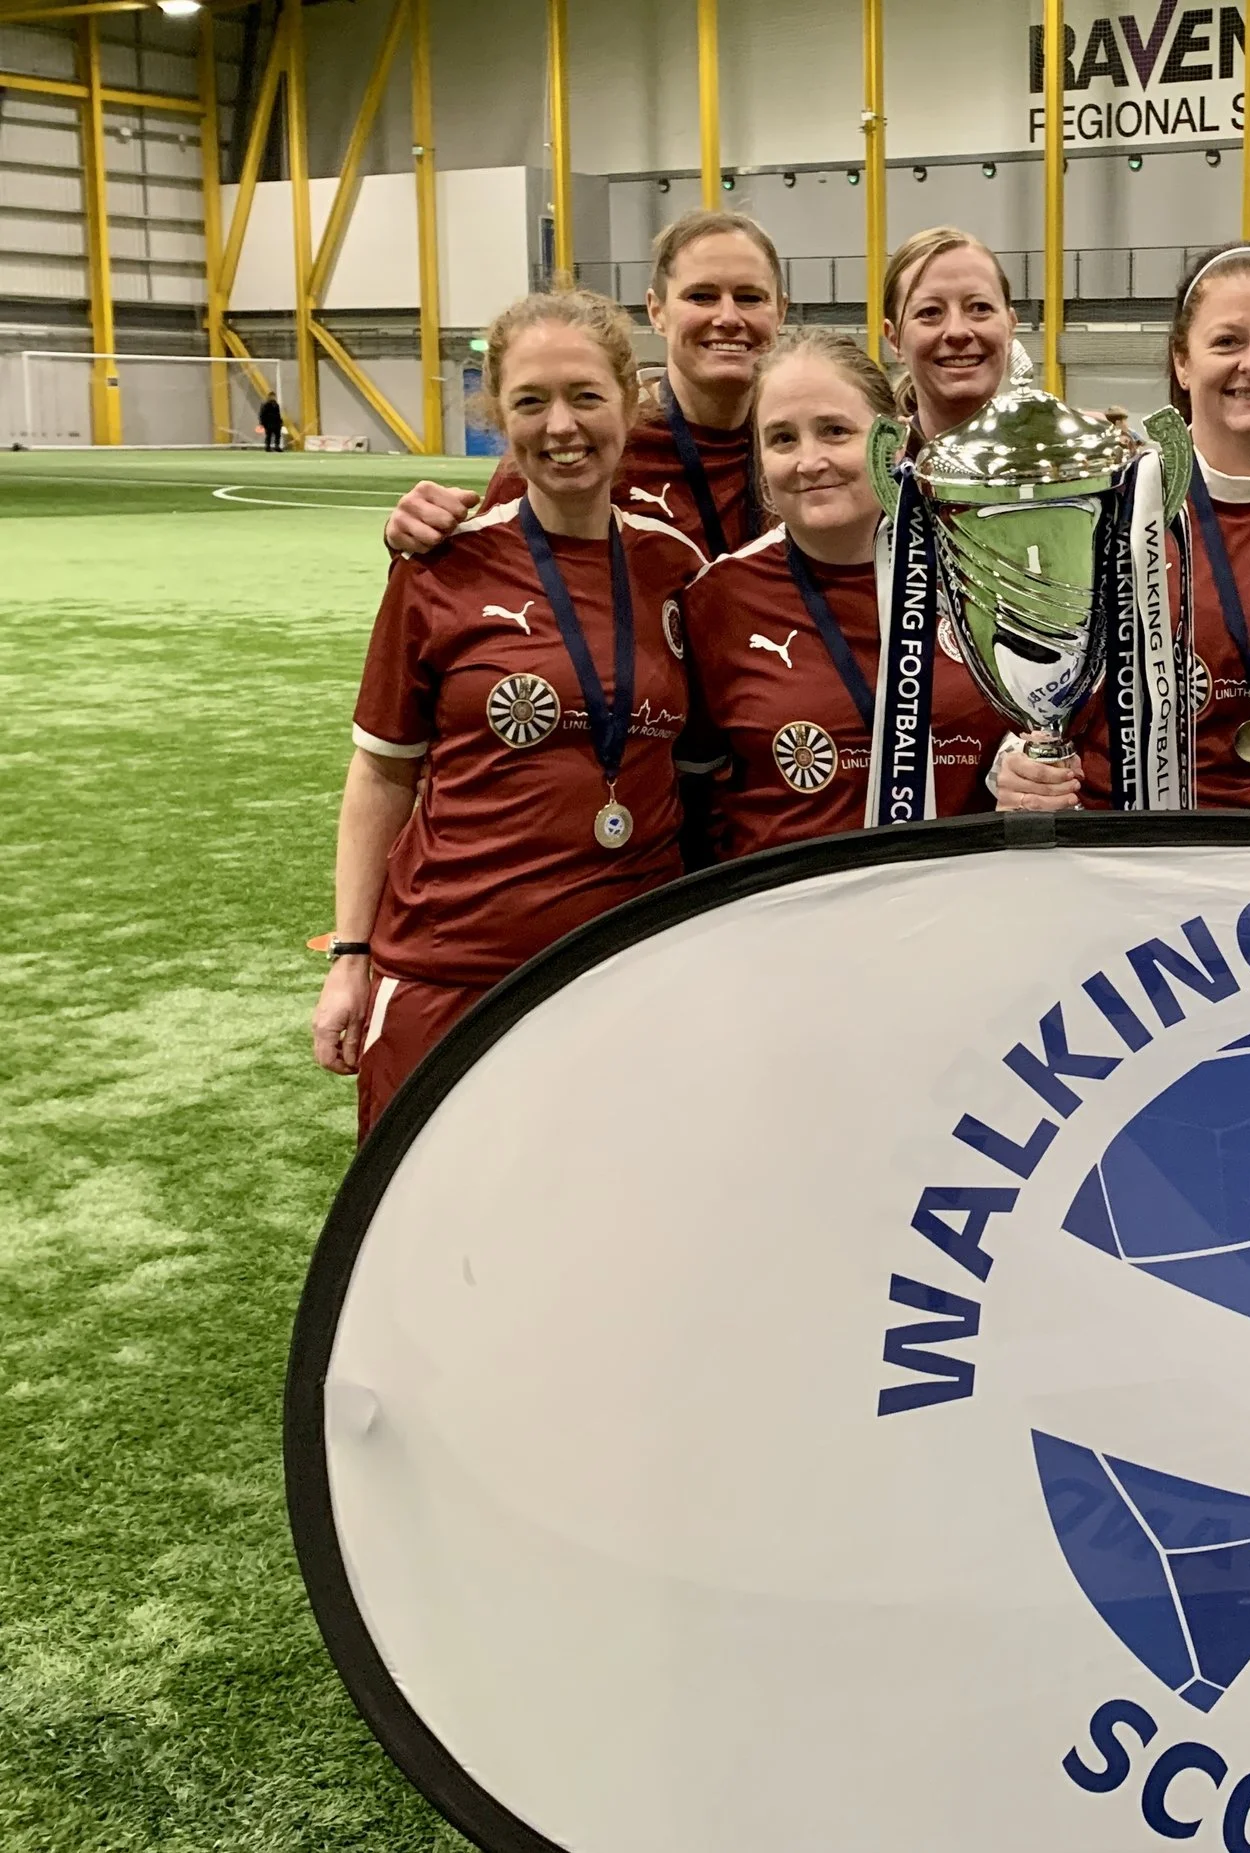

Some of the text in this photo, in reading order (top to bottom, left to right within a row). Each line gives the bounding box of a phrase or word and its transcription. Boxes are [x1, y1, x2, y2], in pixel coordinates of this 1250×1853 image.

[890, 506, 928, 824] WALKING FOOTBALL SC
[933, 754, 982, 765] UNDTABL
[1144, 519, 1172, 802] WALKING FOOTBALL
